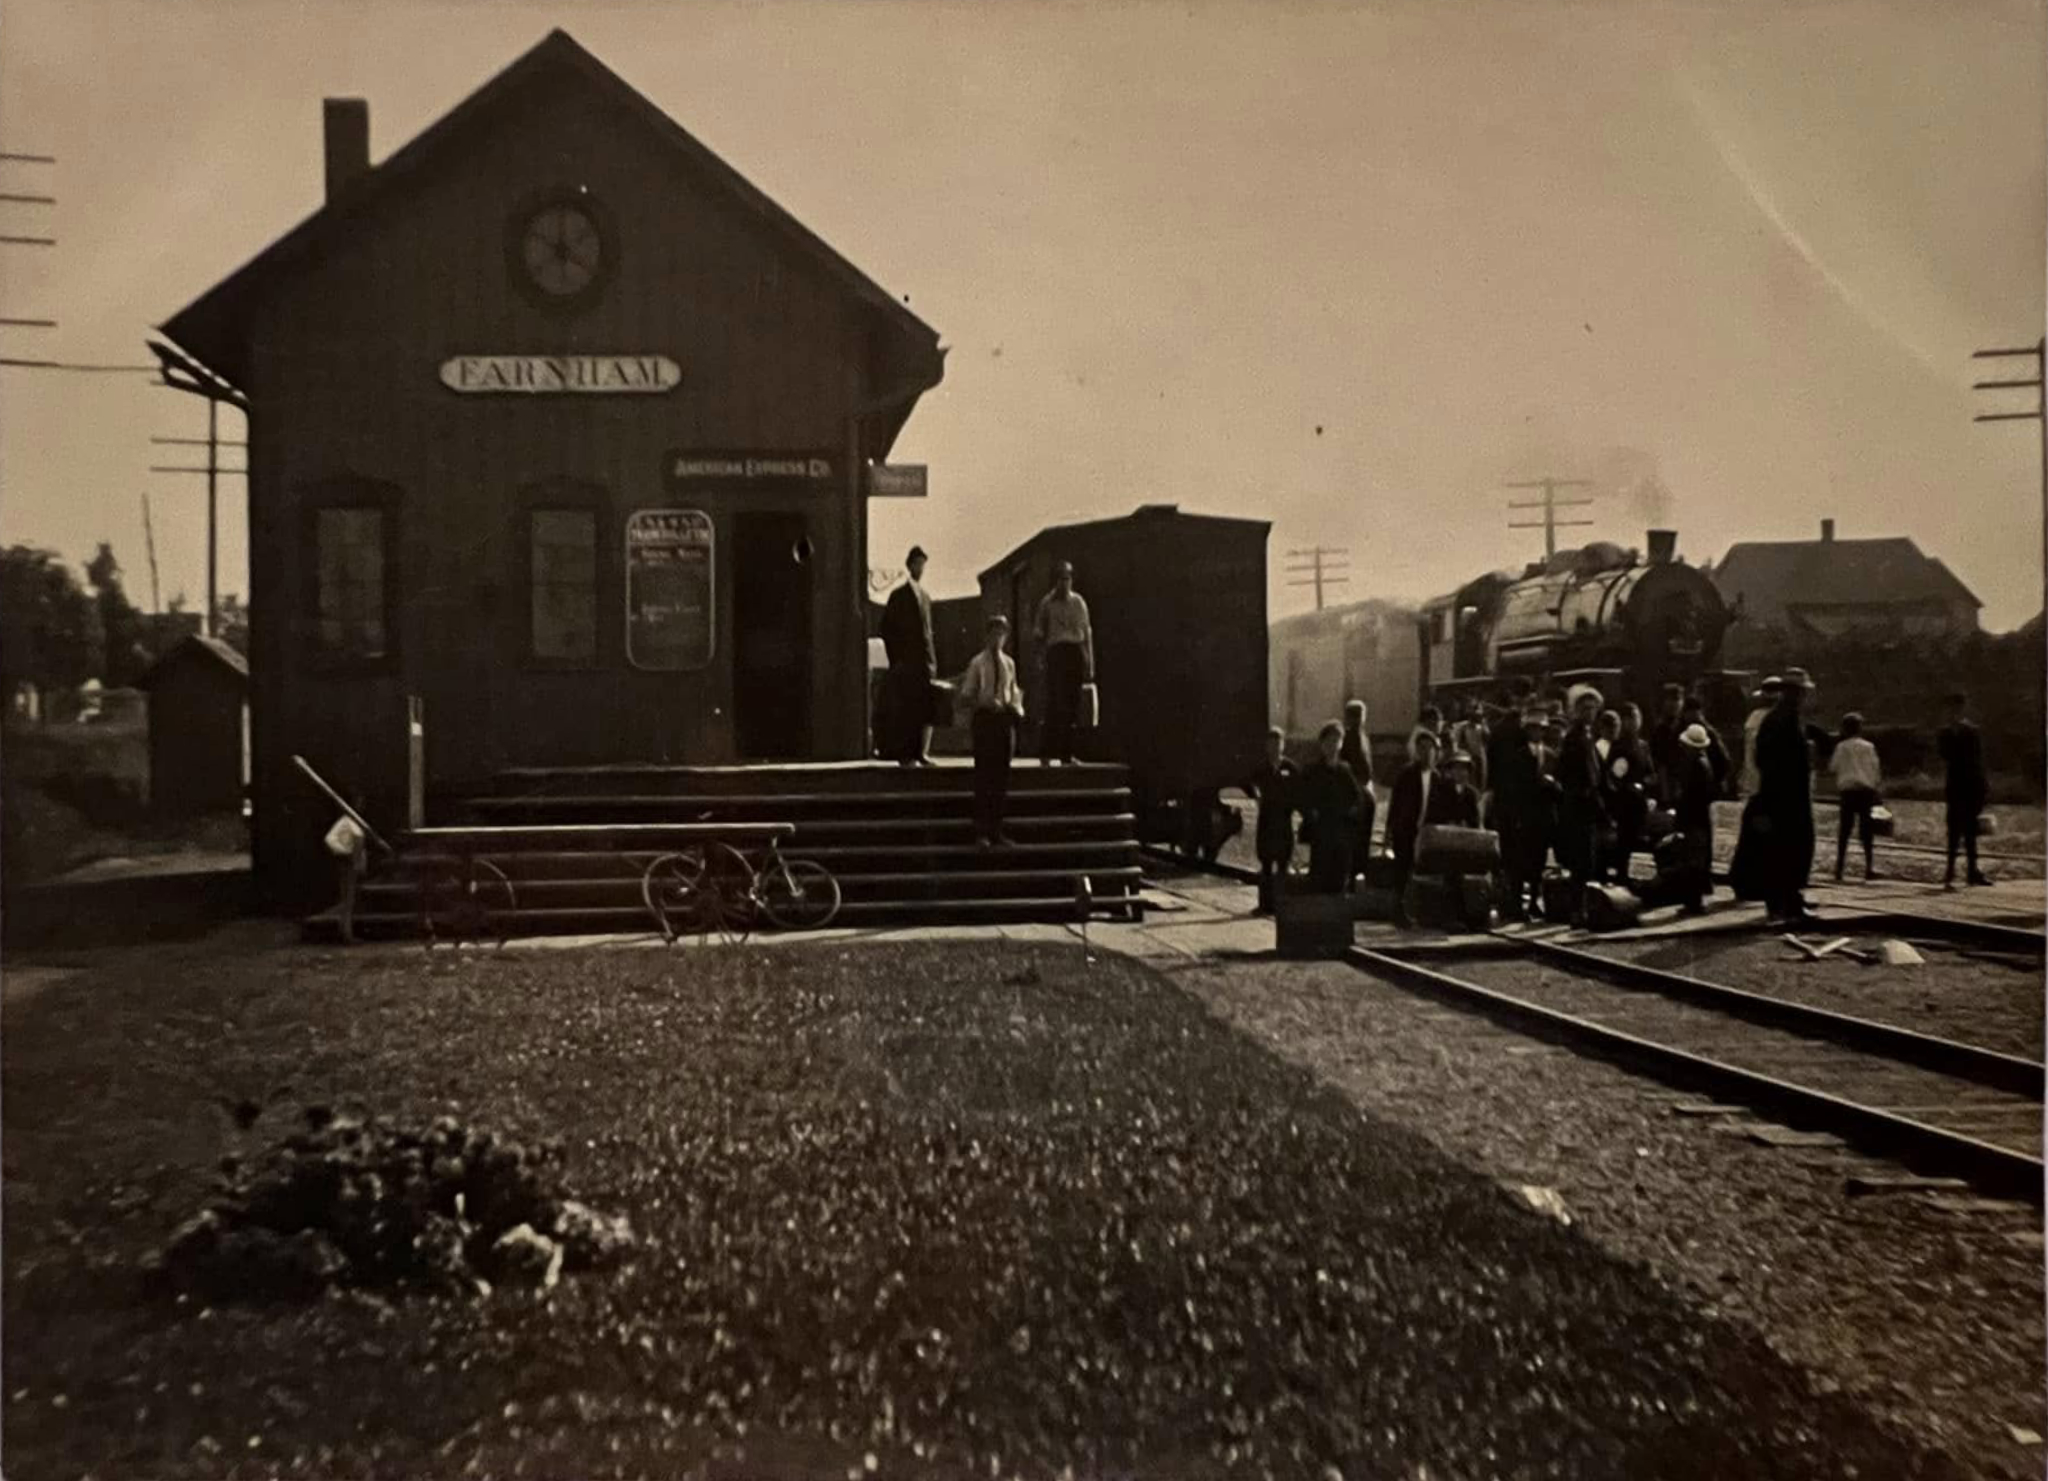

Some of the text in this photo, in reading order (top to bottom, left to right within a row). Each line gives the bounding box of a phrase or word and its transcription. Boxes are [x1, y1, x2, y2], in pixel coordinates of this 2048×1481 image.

[458, 358, 664, 386] FARNHAM
[675, 459, 743, 476] AMERICAN
[745, 458, 806, 477] EXPRESS
